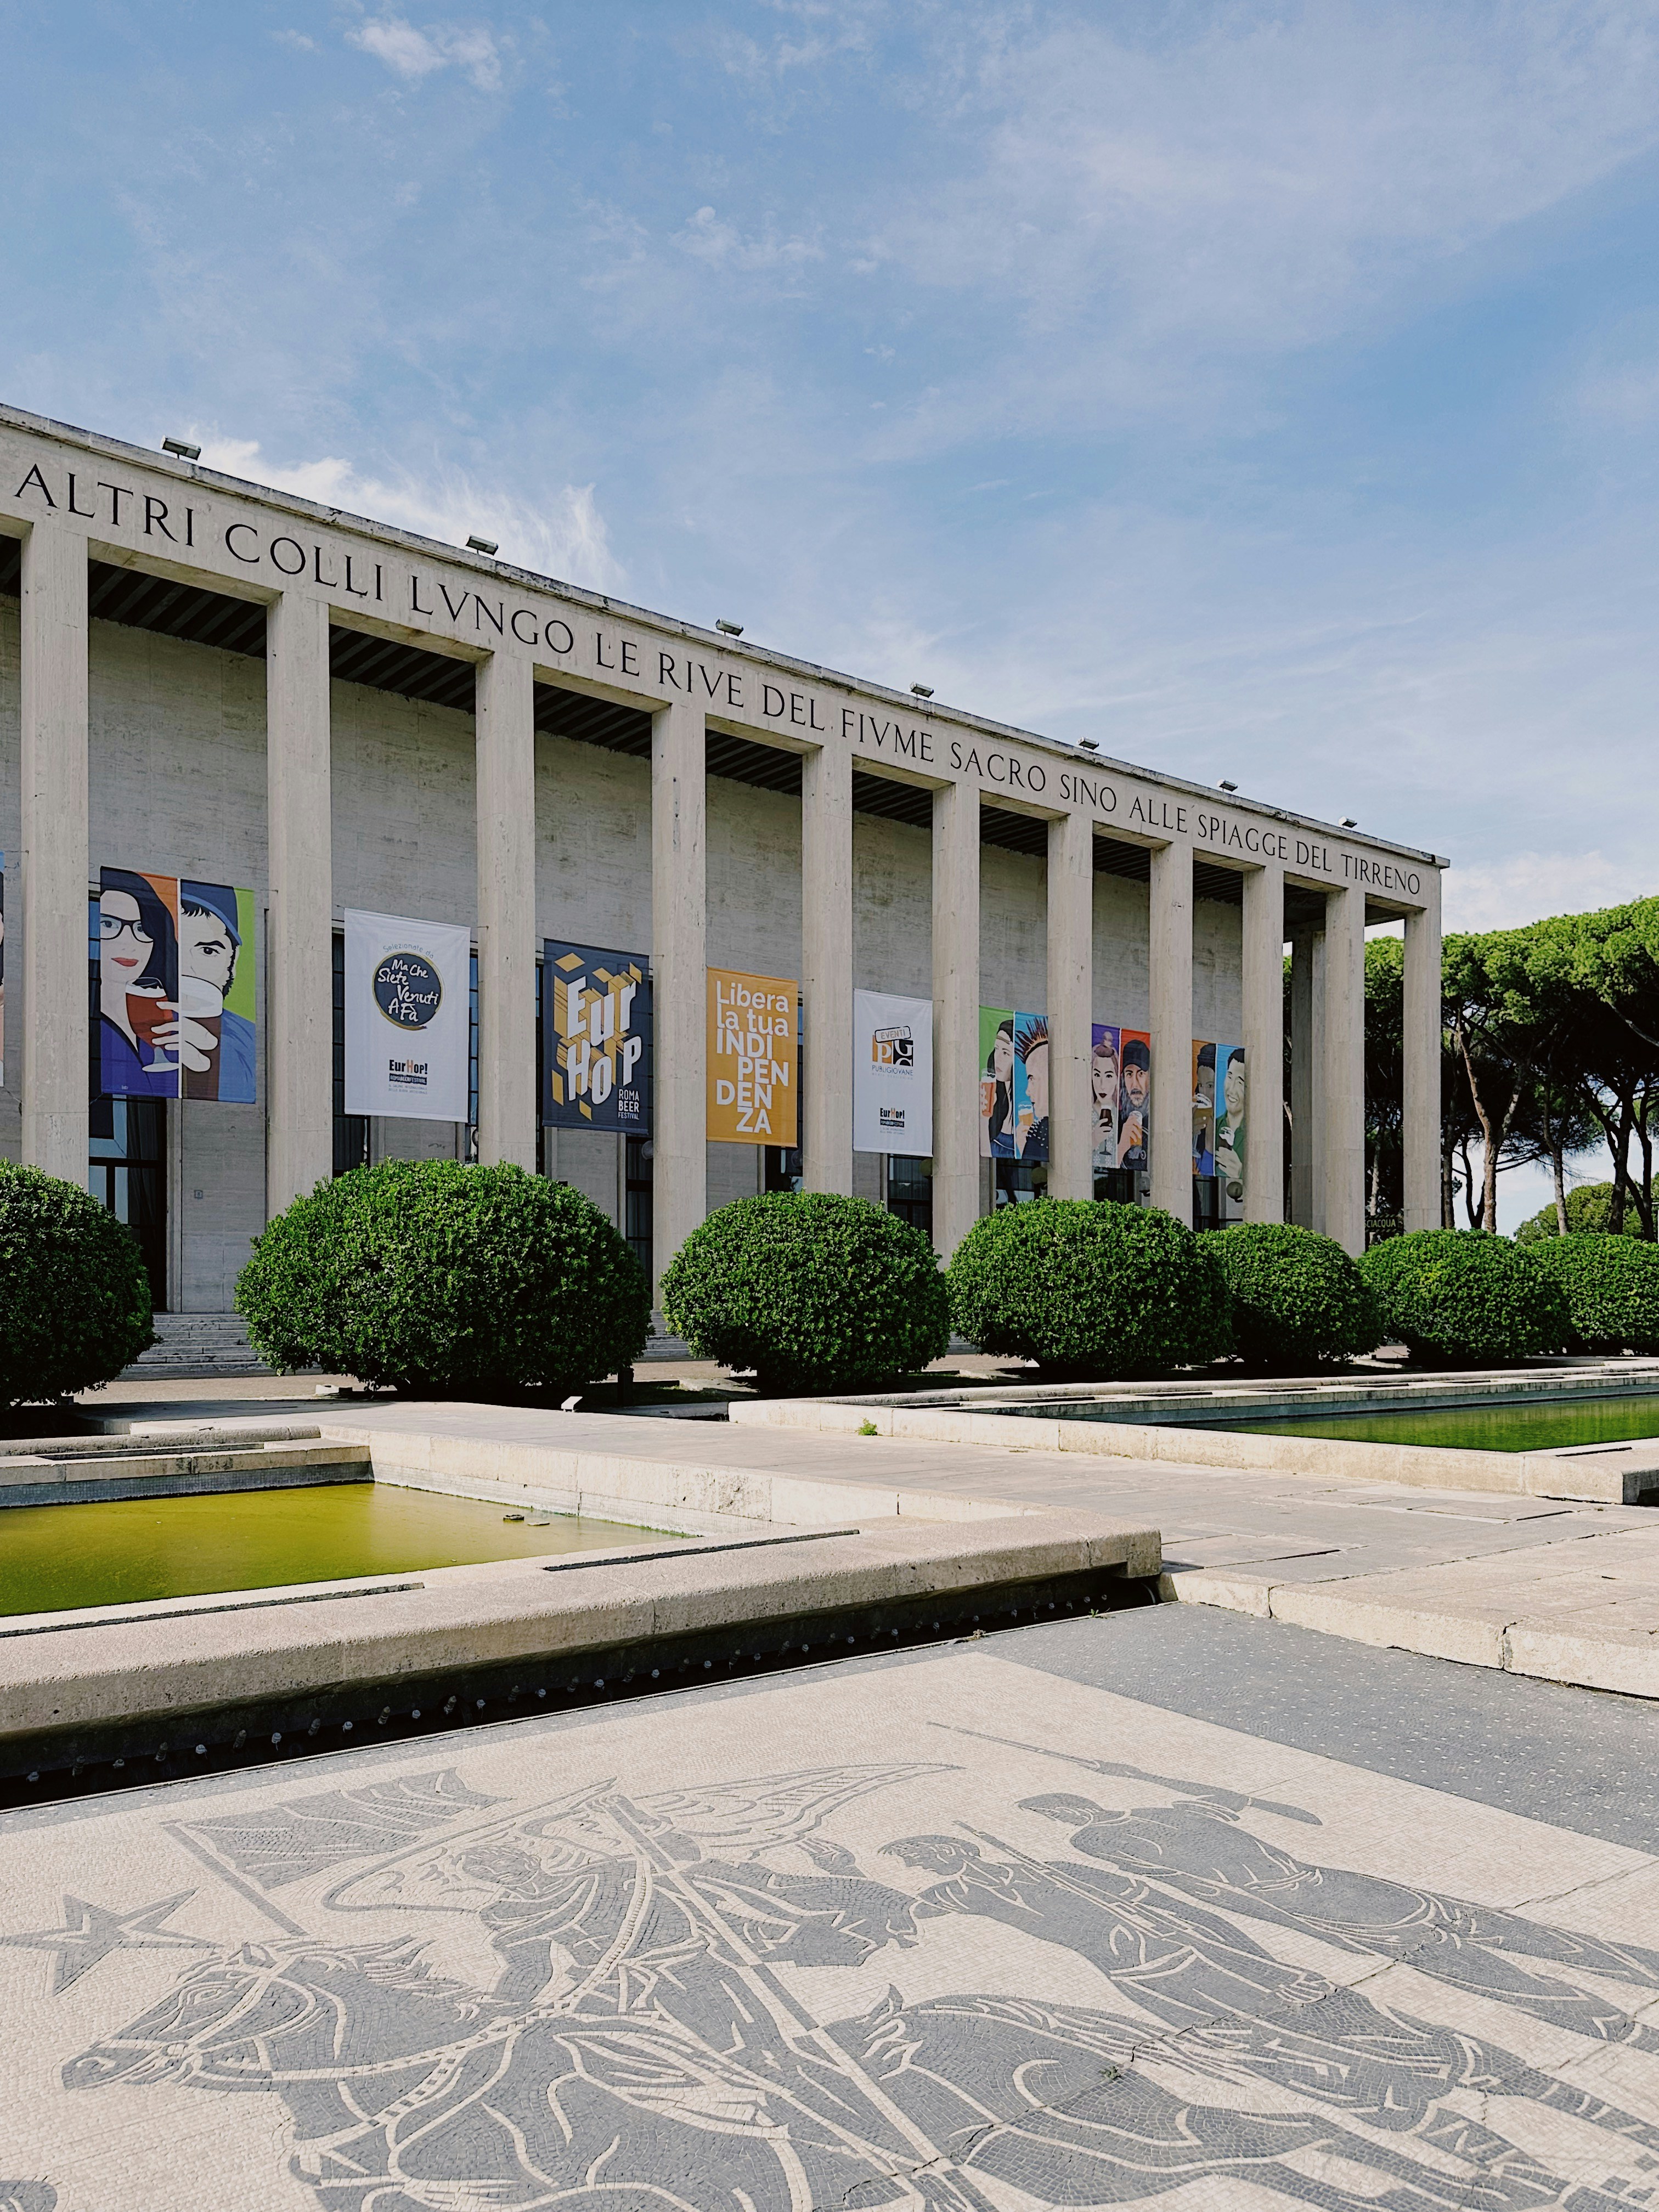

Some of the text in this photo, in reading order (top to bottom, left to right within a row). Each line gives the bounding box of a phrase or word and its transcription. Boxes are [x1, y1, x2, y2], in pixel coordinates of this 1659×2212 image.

[14, 464, 1421, 895] ALTRI COLLI LVNGO LE RIVE DEL FIVME SACRO SINO ALLE SPIAGGE DEL TIRRENO
[377, 967, 409, 985] Siete
[391, 959, 428, 978] Ma Che
[397, 985, 439, 1005] Venuti
[716, 980, 789, 1013] Libera
[388, 998, 399, 1014] A
[716, 1002, 789, 1037] la tua
[716, 1028, 773, 1060] INDI
[880, 1029, 906, 1040] EVENTI
[737, 1056, 789, 1087] PEN
[872, 1065, 913, 1076] PUBLIGIOVANE
[619, 1088, 639, 1101] ROMA
[716, 1079, 772, 1110] DEN
[618, 1100, 640, 1113] BEER
[618, 1111, 640, 1120] FESTIVAL
[736, 1106, 772, 1135] ZA
[1365, 1219, 1396, 1228] CIACQUA
